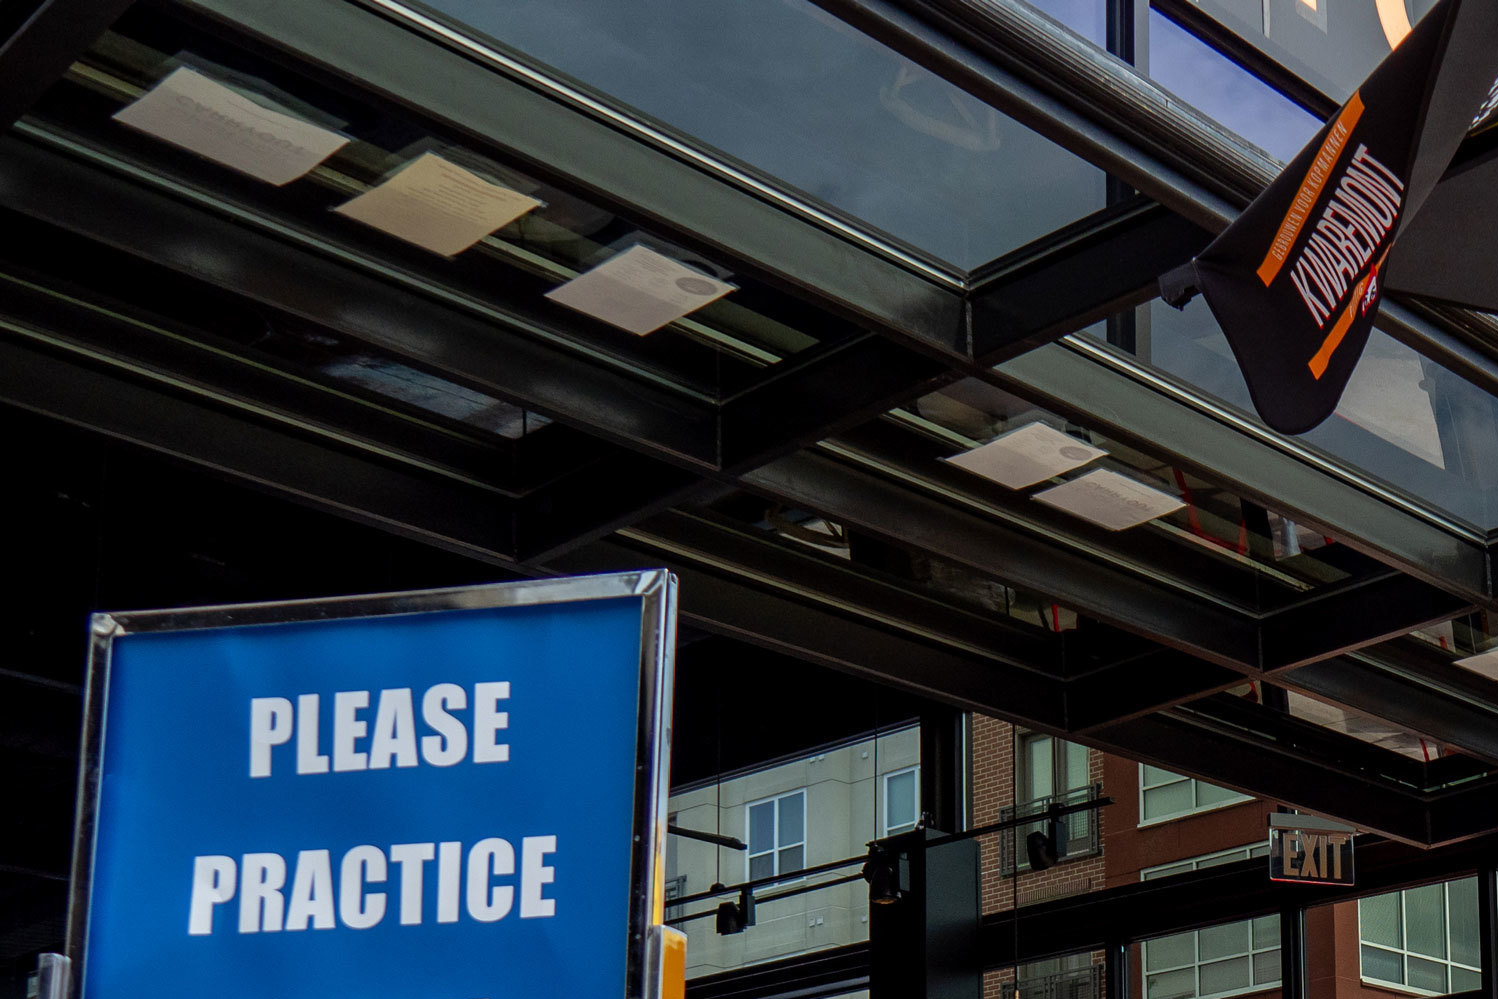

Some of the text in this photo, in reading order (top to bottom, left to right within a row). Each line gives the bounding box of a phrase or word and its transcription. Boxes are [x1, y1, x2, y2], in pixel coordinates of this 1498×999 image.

[1293, 186, 1315, 216] VOOR
[1306, 121, 1348, 190] KOPMANNEN
[1290, 142, 1404, 329] KWAREMONT
[249, 681, 511, 778] PLEASE
[187, 835, 557, 935] PRACTICE
[1283, 833, 1347, 879] EXIT
